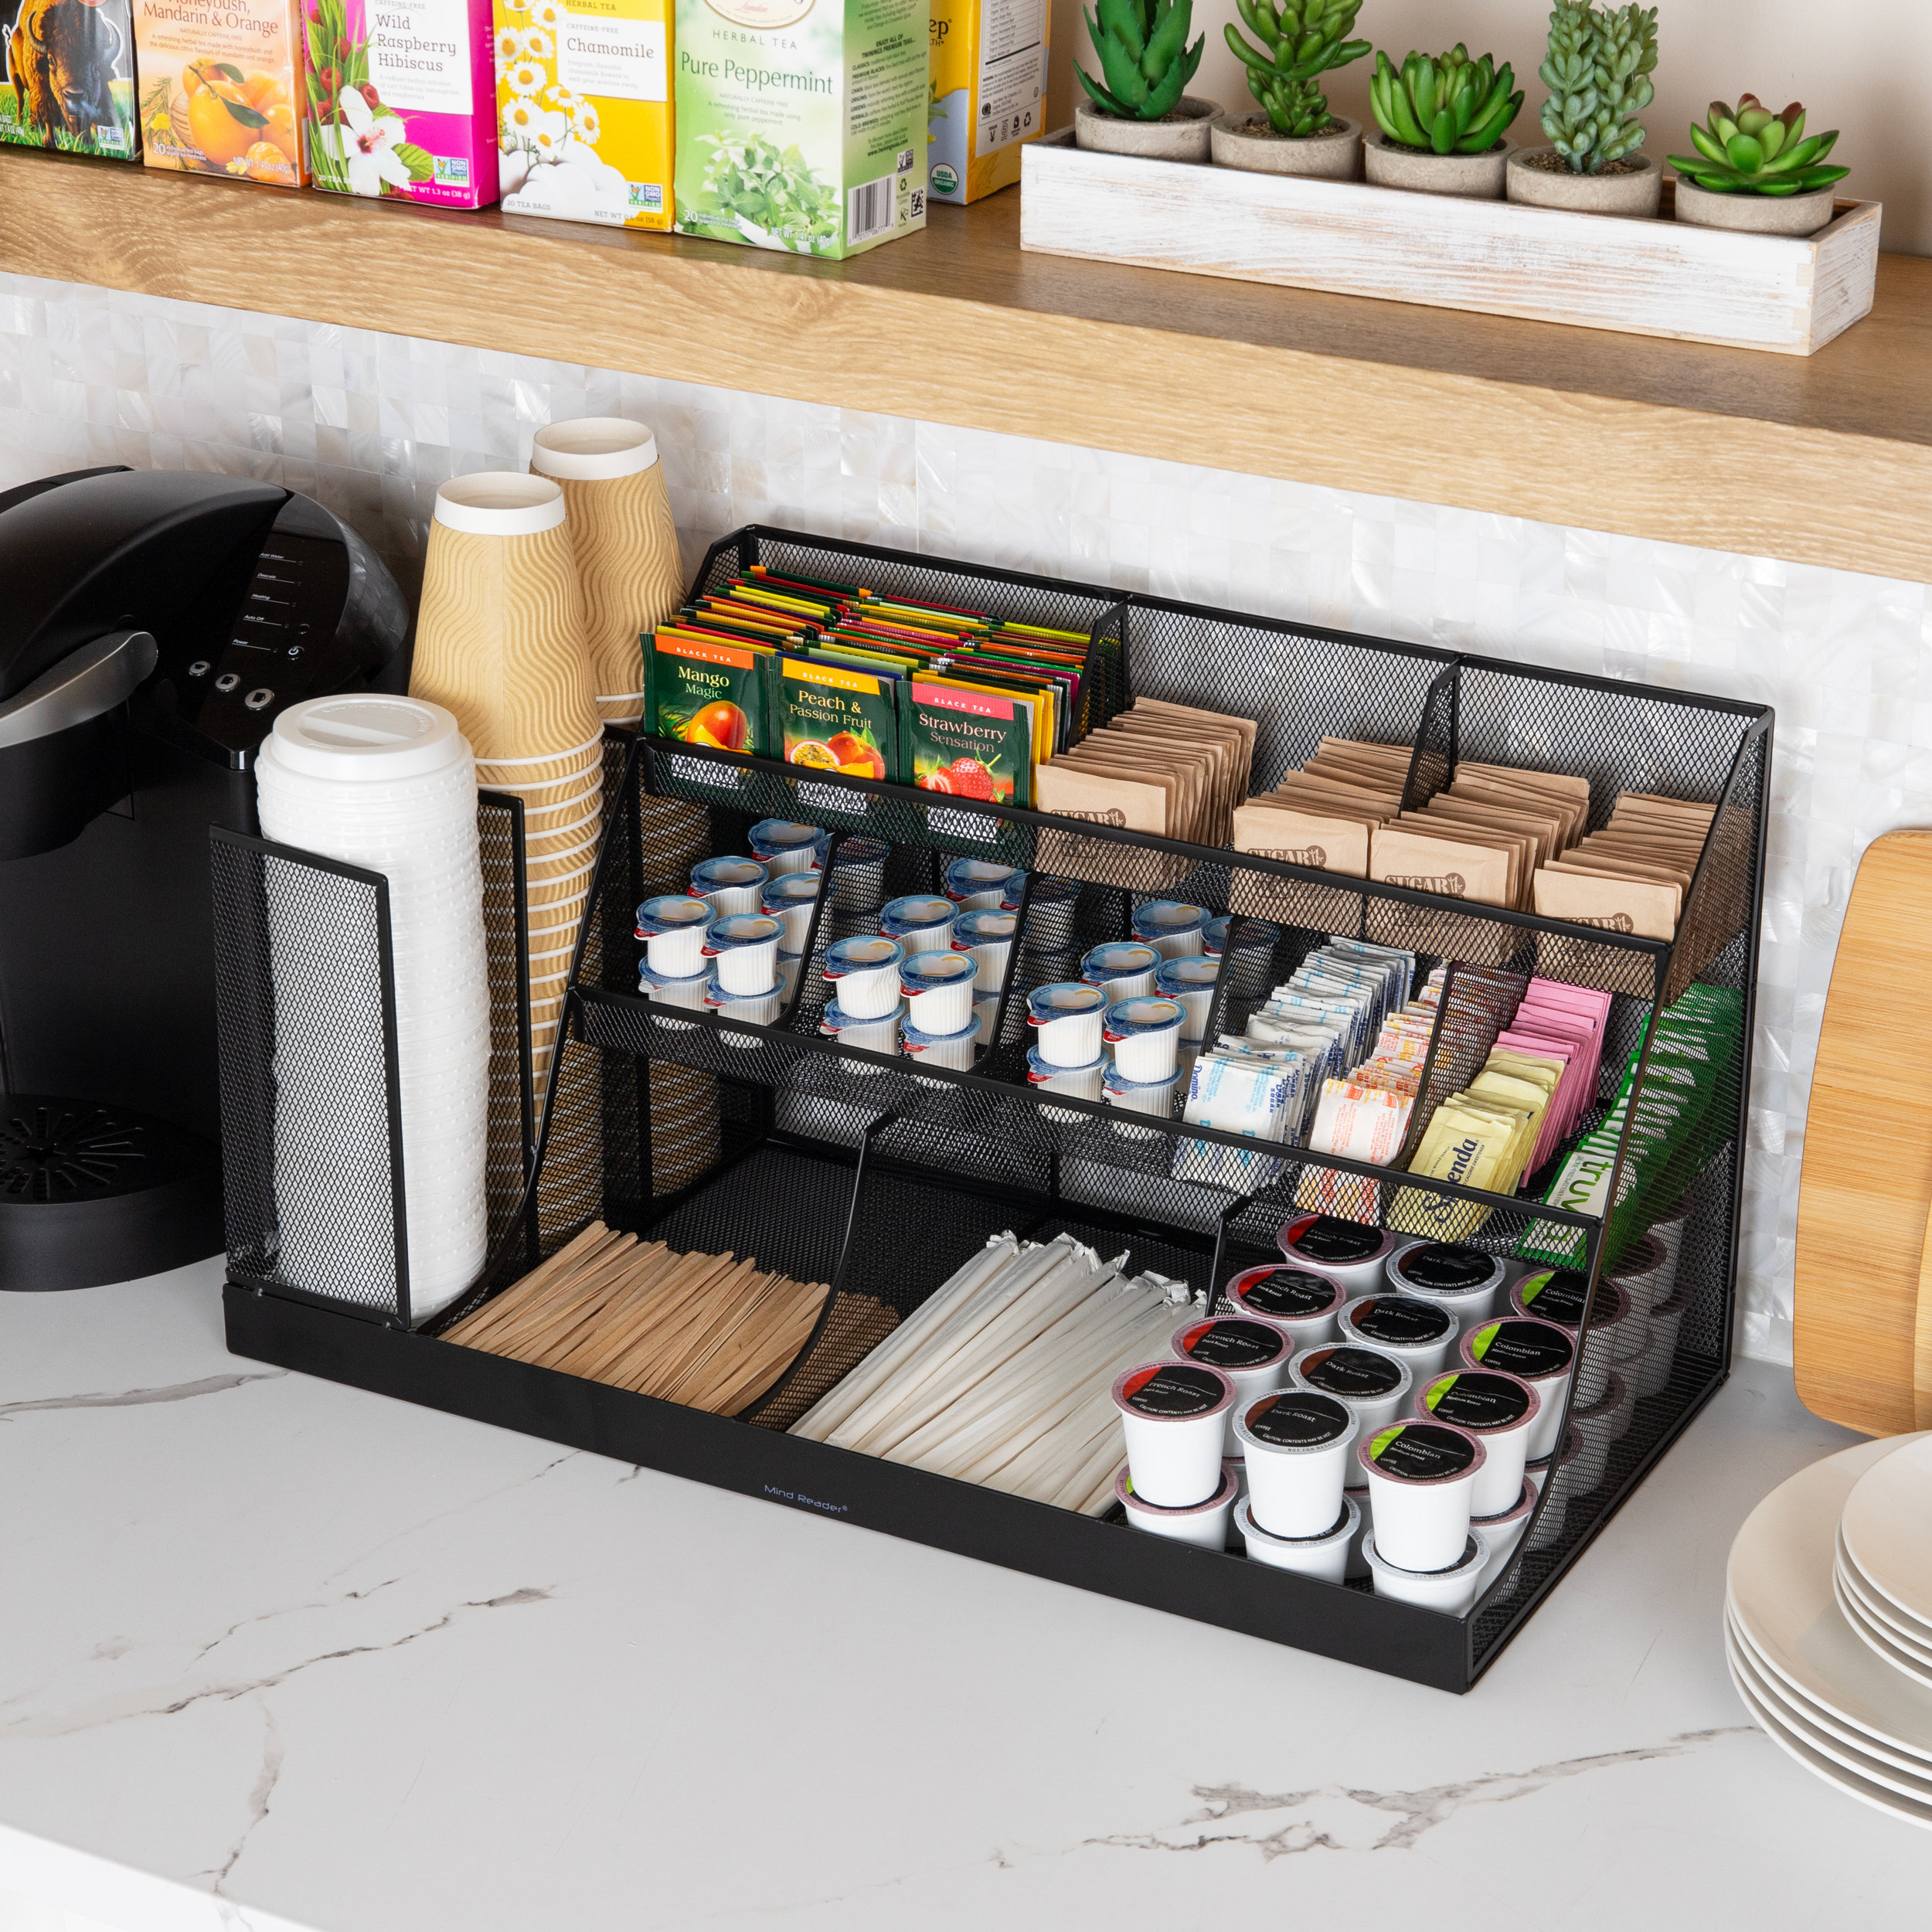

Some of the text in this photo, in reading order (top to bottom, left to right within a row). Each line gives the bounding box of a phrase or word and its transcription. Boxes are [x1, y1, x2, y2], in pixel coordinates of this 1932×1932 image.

[374, 0, 426, 9] CAFFEINE-FREE
[566, 0, 598, 9] HERBAL
[144, 3, 278, 38] Mandarin & Orange
[376, 14, 410, 29] Wild
[179, 28, 206, 36] NATURALLY
[566, 23, 619, 34] CAFFEINE-FREE
[157, 34, 181, 43] refreshing
[182, 37, 197, 46] herbal
[234, 44, 261, 55] honeybush
[377, 33, 456, 56] Raspberry
[713, 29, 798, 49] HERBAL TEA
[876, 38, 889, 47] ENJOY
[158, 43, 245, 59] delicious flavours mandarin
[567, 37, 654, 59] Chamomile
[862, 41, 903, 58] TWININGS PREMIUM
[379, 53, 443, 72] Hibiscus
[682, 51, 719, 78] Pure
[725, 59, 833, 95] Peppermint
[719, 93, 750, 102] NATURALLY
[750, 97, 775, 106] CAFFEINE
[713, 101, 740, 112] refreshing
[742, 105, 758, 114] herbal
[770, 110, 785, 118] made
[786, 112, 801, 122] using
[723, 111, 736, 120] only
[152, 142, 166, 155] 20
[245, 158, 253, 168] WT
[936, 170, 953, 179] USDA
[934, 179, 954, 188] ORGANIC
[418, 185, 430, 194] WT
[432, 188, 441, 196] 1.3
[532, 202, 551, 211] BAGS
[629, 199, 661, 208] VERIFIED
[594, 209, 608, 218] NET
[684, 209, 698, 223] 20
[676, 647, 707, 658] BLACK
[678, 665, 730, 688] Mango
[803, 672, 834, 683] BLACK
[685, 682, 723, 699] Magic
[798, 689, 862, 714] Peach &
[934, 697, 992, 714] BLACK TEA
[790, 703, 872, 730] Passion Fruit
[919, 713, 1007, 743] Strawberry
[930, 731, 995, 753] Sensation
[1191, 1064, 1202, 1100] Domino
[1464, 1145, 1485, 1182] CALORIE SWEETENER
[1257, 1284, 1282, 1298] Dark Roast
[1290, 1289, 1312, 1301] Roast
[1247, 1294, 1262, 1303] COFFEE
[1395, 1312, 1420, 1322] Roast
[1206, 1333, 1260, 1349] French Roast
[1495, 1342, 1541, 1355] Colombian
[1325, 1361, 1370, 1379] Dark Roast
[1148, 1382, 1201, 1398] French Roast
[1451, 1391, 1497, 1404] Colombian
[1292, 1413, 1317, 1423] Roast
[1316, 1440, 1338, 1451] RESALE
[1389, 1447, 1410, 1457] Medium
[1395, 1440, 1440, 1460] Colombian
[764, 1485, 794, 1499] Mind
[1318, 1535, 1340, 1545] RESALE
[1443, 1569, 1465, 1578] RESALE
